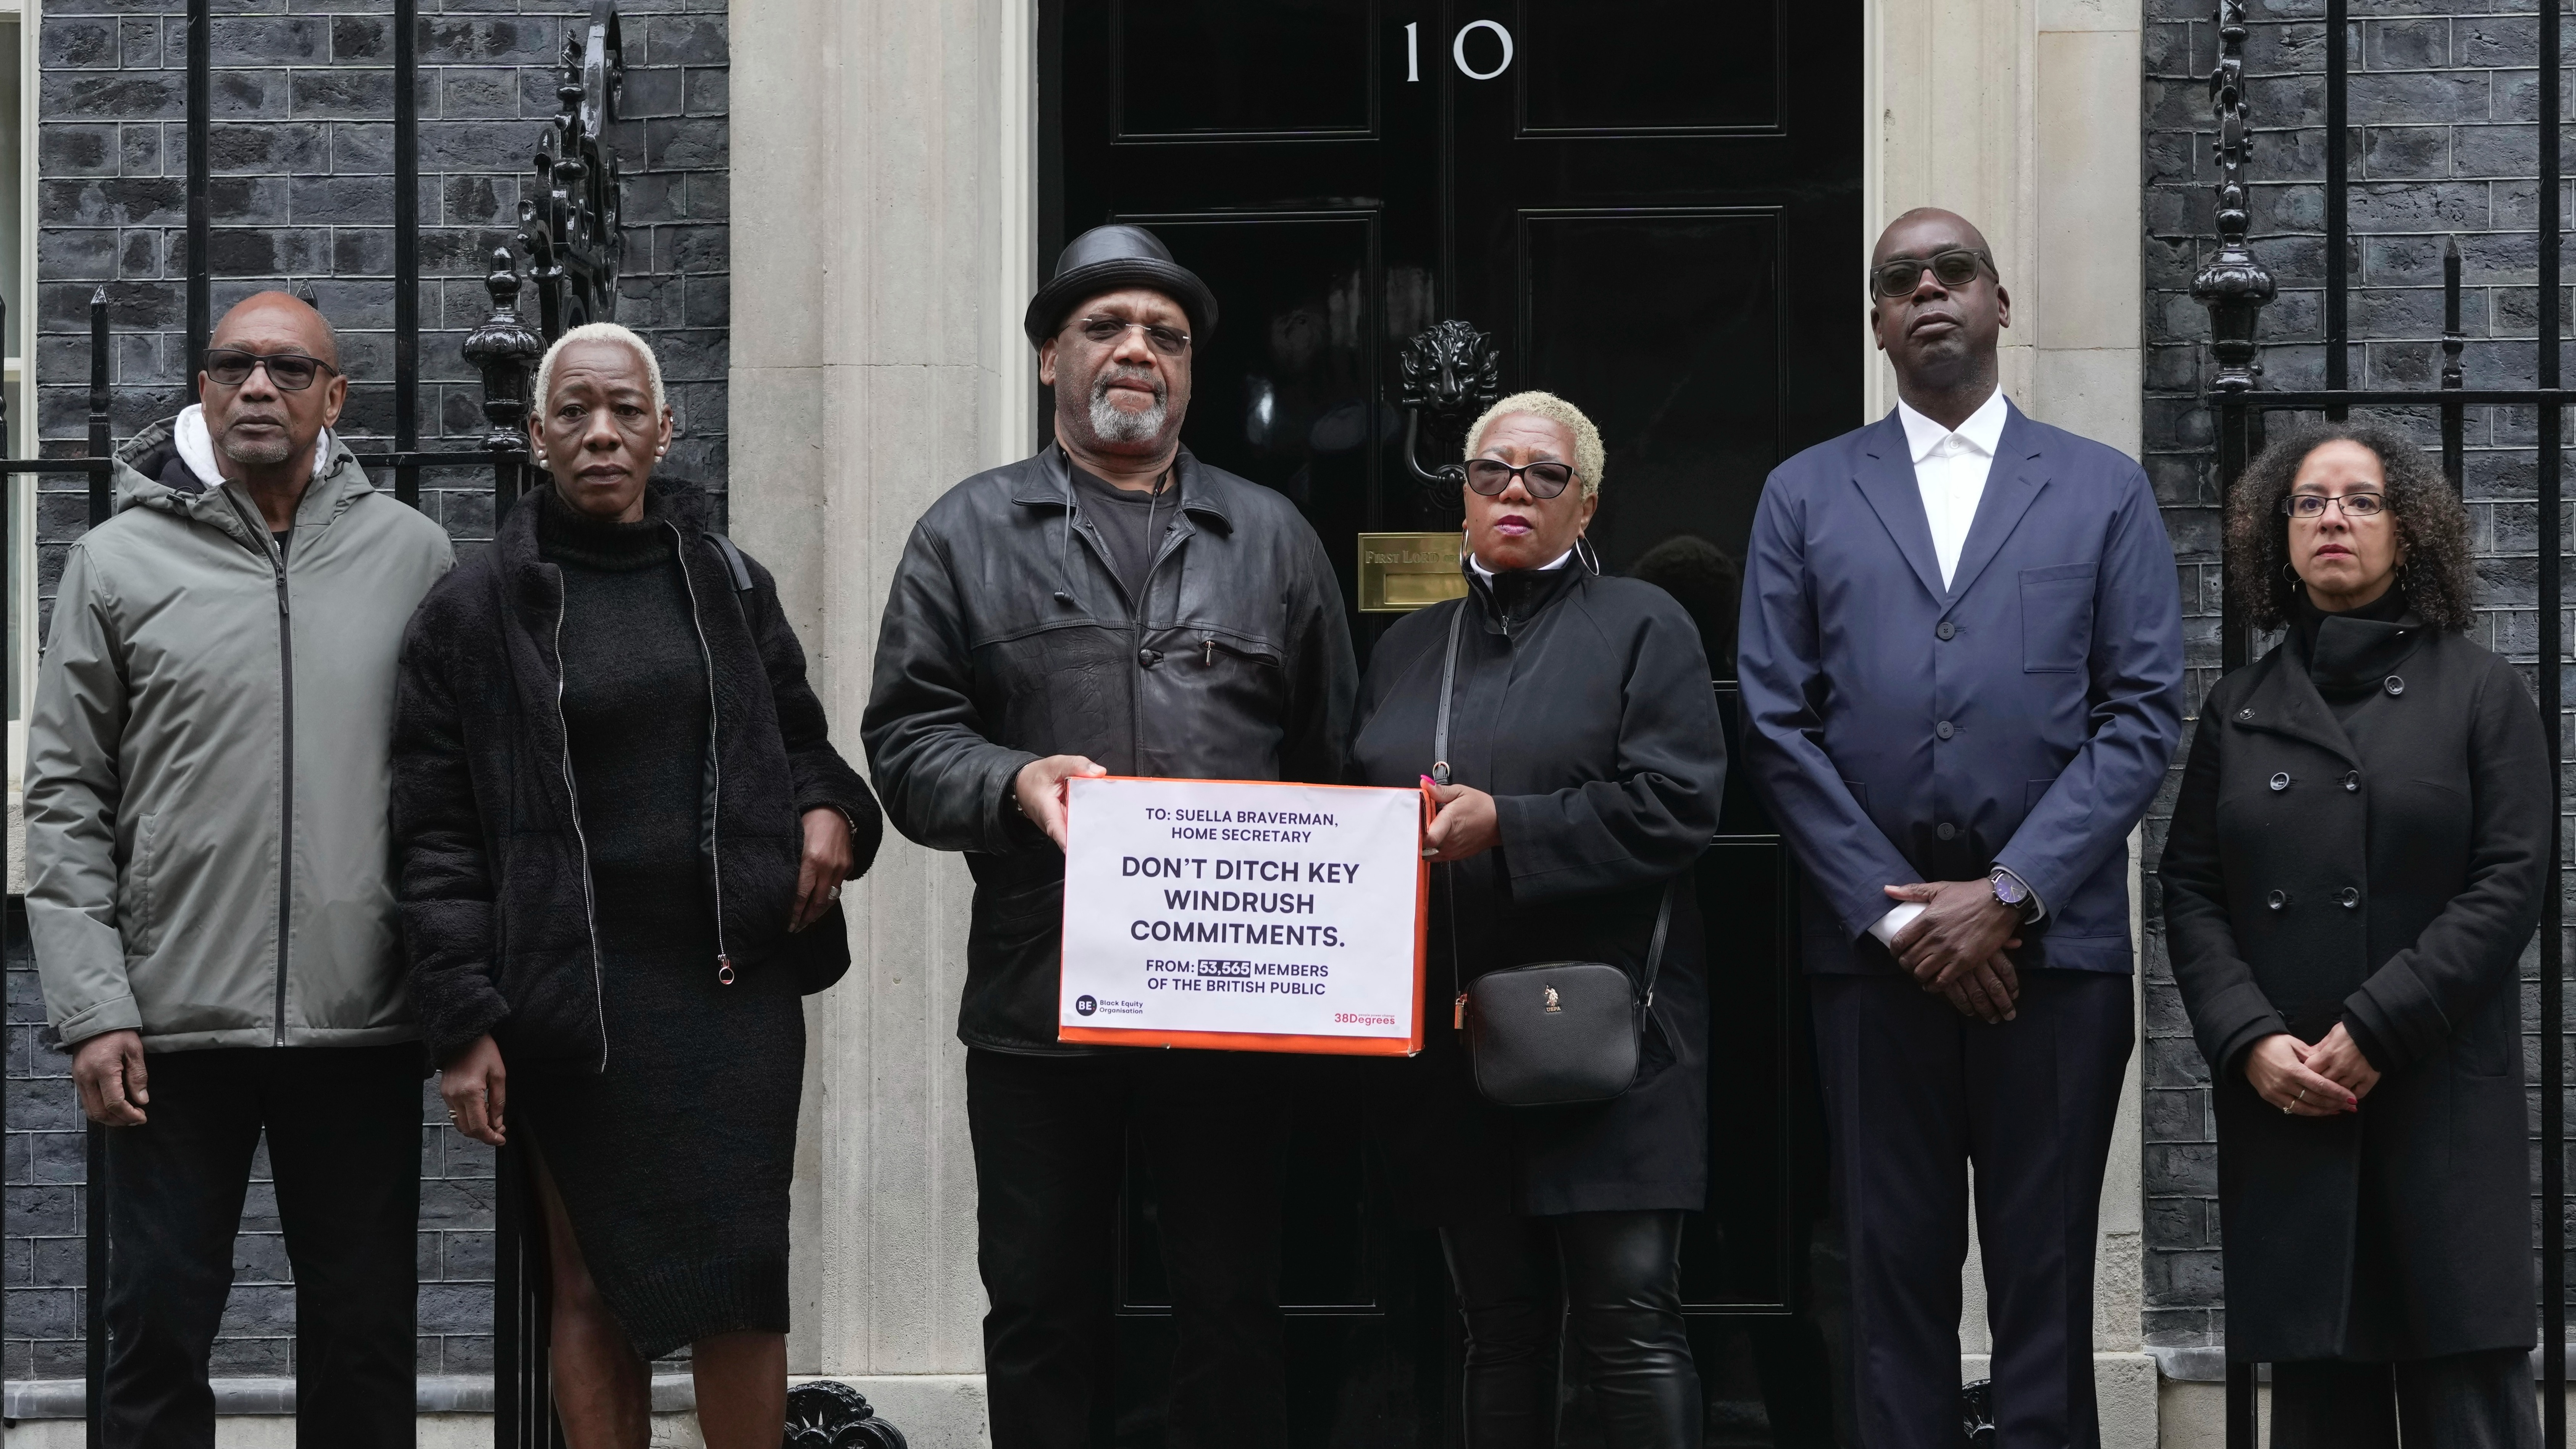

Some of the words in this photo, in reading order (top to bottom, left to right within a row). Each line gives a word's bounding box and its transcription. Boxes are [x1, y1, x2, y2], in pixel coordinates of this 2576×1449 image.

[1404, 19, 1513, 81] 10
[1145, 808, 1171, 821] TO:
[1176, 809, 1232, 823] SUELLA
[1237, 811, 1338, 828] BRAVERMAN,
[1172, 827, 1218, 840] HOME
[1222, 829, 1311, 843] SECRETARY
[1122, 856, 1208, 879] DON’T
[1216, 859, 1298, 882] DITCH
[1308, 862, 1360, 884] KEY
[1164, 889, 1314, 914] WINDRUSH
[1131, 920, 1345, 947] COMMITMENTS.
[1146, 959, 1195, 973] FROM:
[1198, 961, 1250, 977] 53,565
[1254, 963, 1329, 977] MEMBERS
[1148, 977, 1168, 990] OF
[1172, 978, 1202, 991] THE
[1206, 979, 1265, 993] BRITISH
[1270, 982, 1326, 995] PUBLIC
[1121, 1000, 1143, 1008] Equity
[1334, 1013, 1395, 1026] 38Degrees
